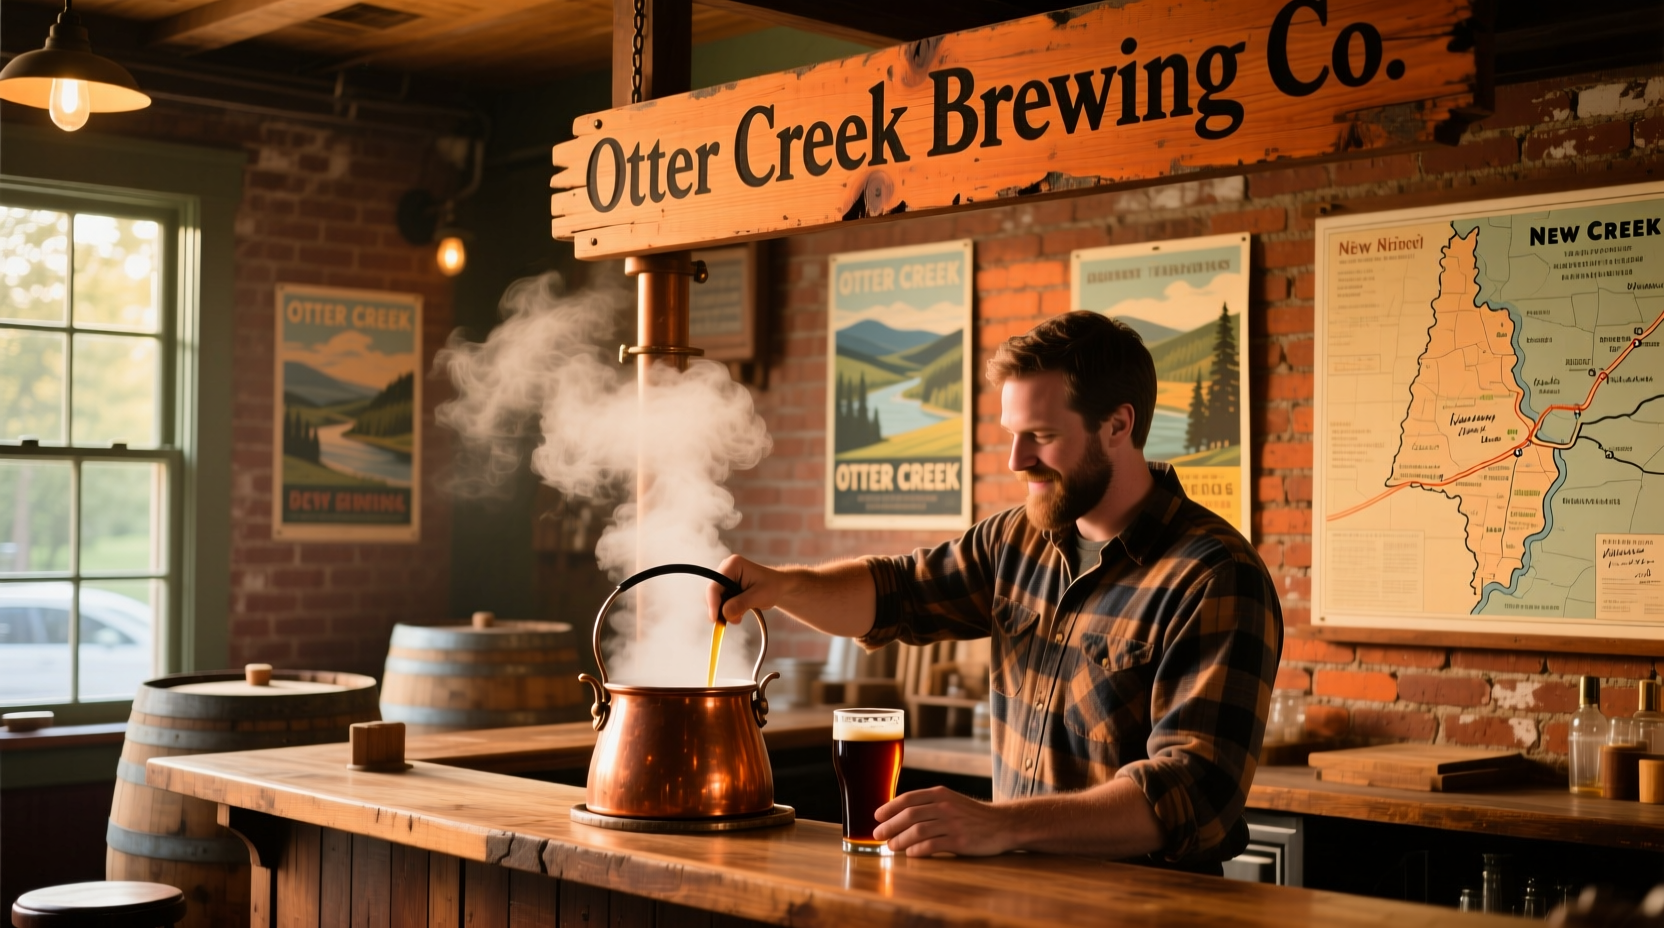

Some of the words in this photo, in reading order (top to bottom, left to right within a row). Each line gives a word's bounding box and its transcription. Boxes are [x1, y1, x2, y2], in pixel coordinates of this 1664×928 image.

[586, 136, 721, 214] Otter
[733, 80, 911, 188] Creek
[926, 36, 1247, 141] Brewing
[1266, 0, 1406, 98] Co.
[1529, 225, 1580, 247] NEW
[1587, 217, 1662, 242] CREEK
[838, 267, 895, 297] OTTER
[899, 260, 961, 292] CREEK
[286, 299, 348, 327] OTTER
[351, 304, 413, 331] CREEK
[835, 461, 895, 492] OTTER
[896, 461, 961, 491] CREEK
